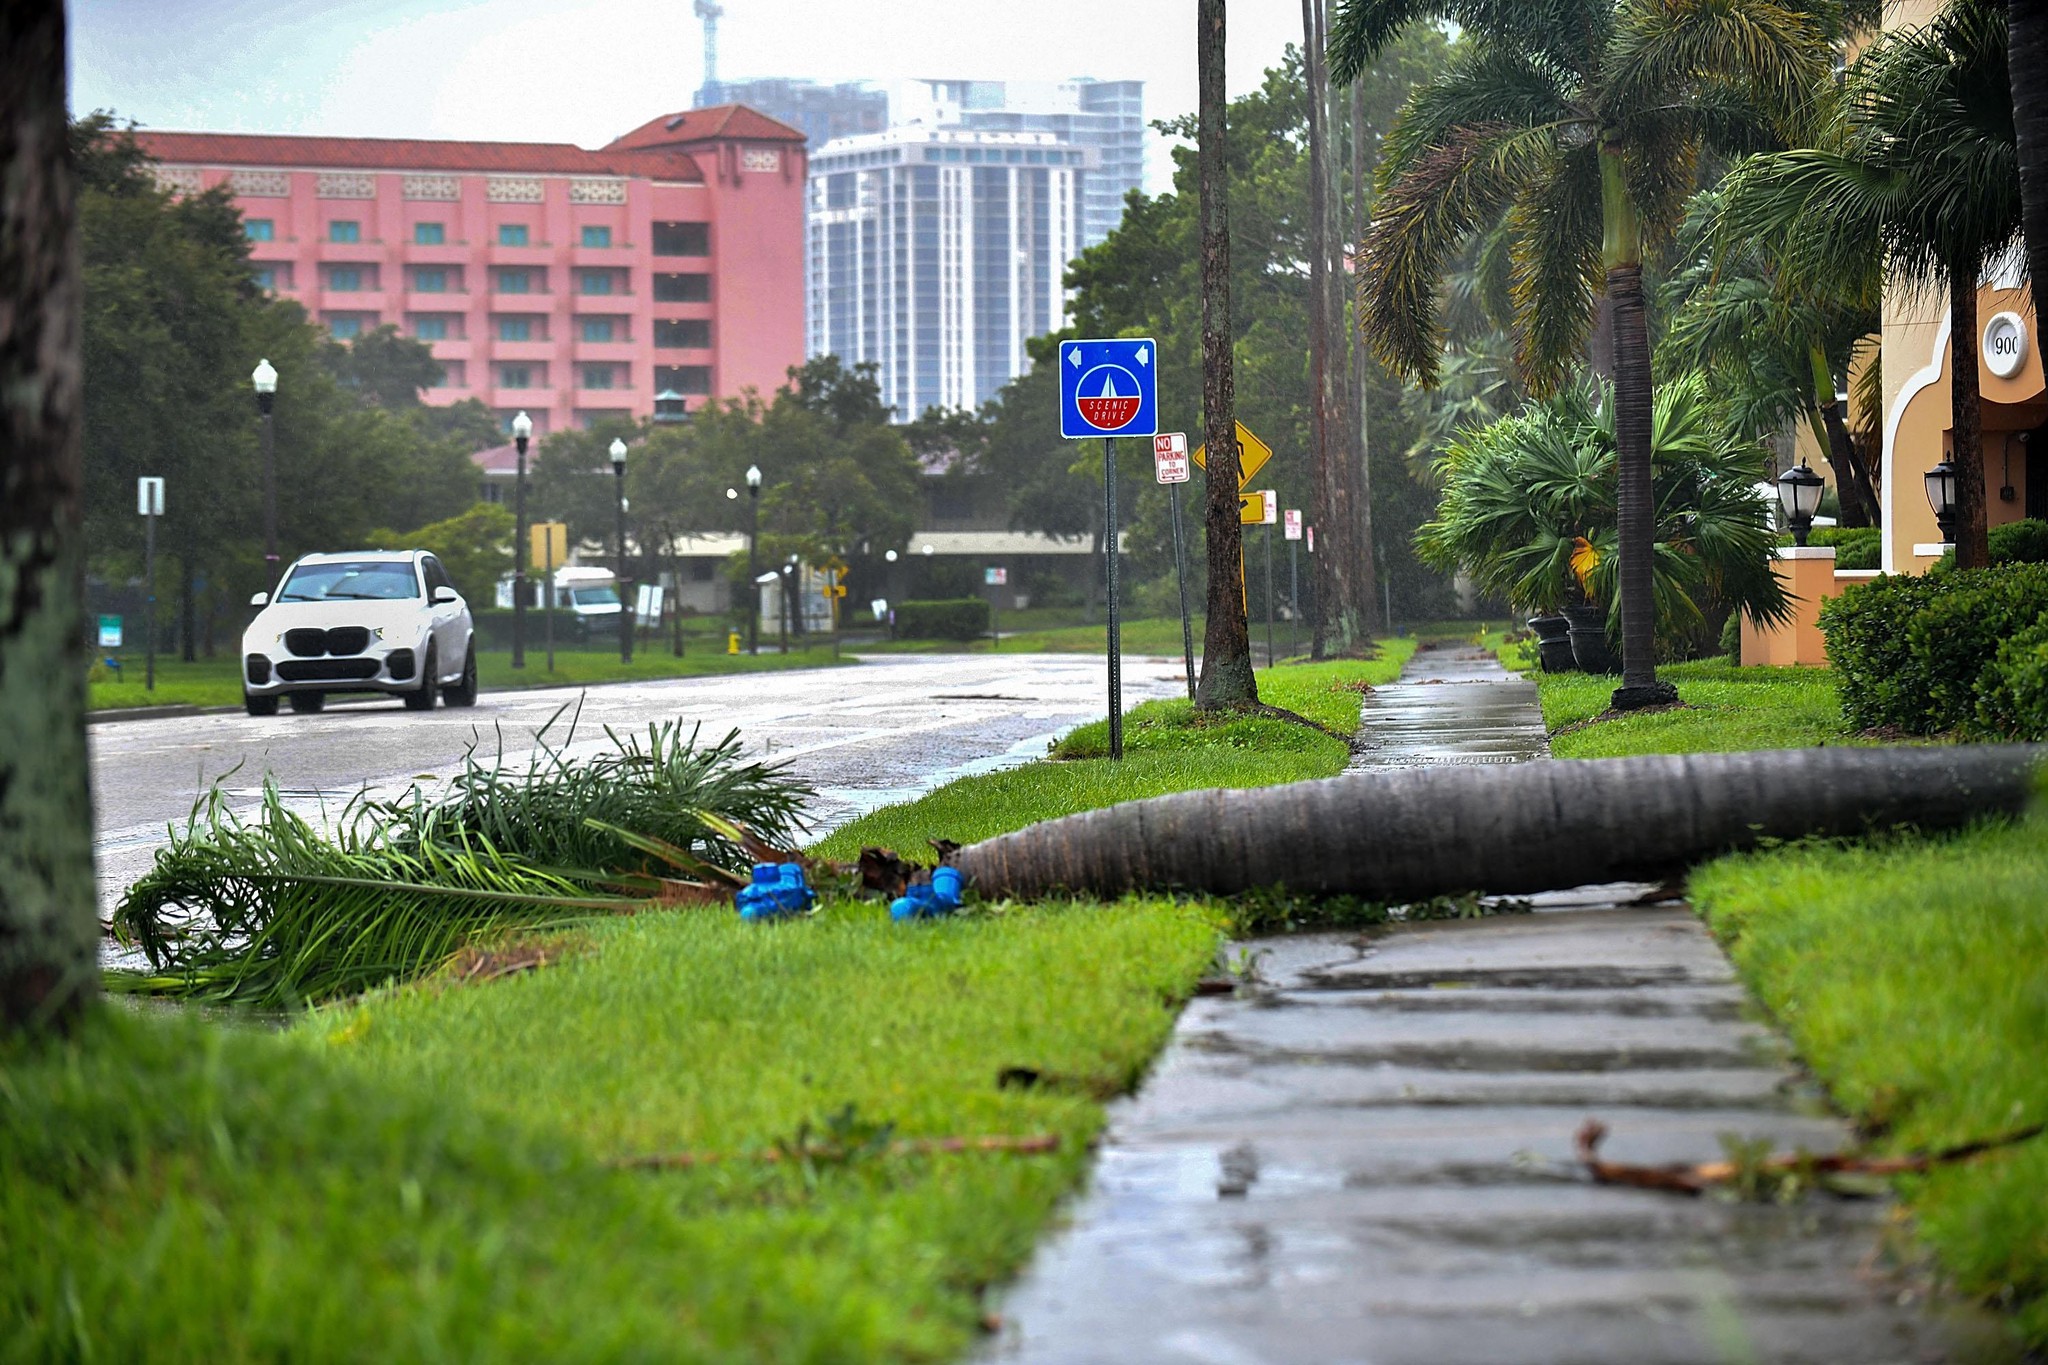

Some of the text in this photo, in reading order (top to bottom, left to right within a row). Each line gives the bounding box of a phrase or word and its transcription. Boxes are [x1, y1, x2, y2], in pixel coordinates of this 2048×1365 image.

[1995, 336, 2018, 355] 900
[1089, 400, 1129, 410] SCENIC
[1094, 411, 1125, 421] DRIVE
[1156, 437, 1171, 450] NO
[1158, 450, 1185, 461] PARKING
[1161, 467, 1184, 476] CORNER
